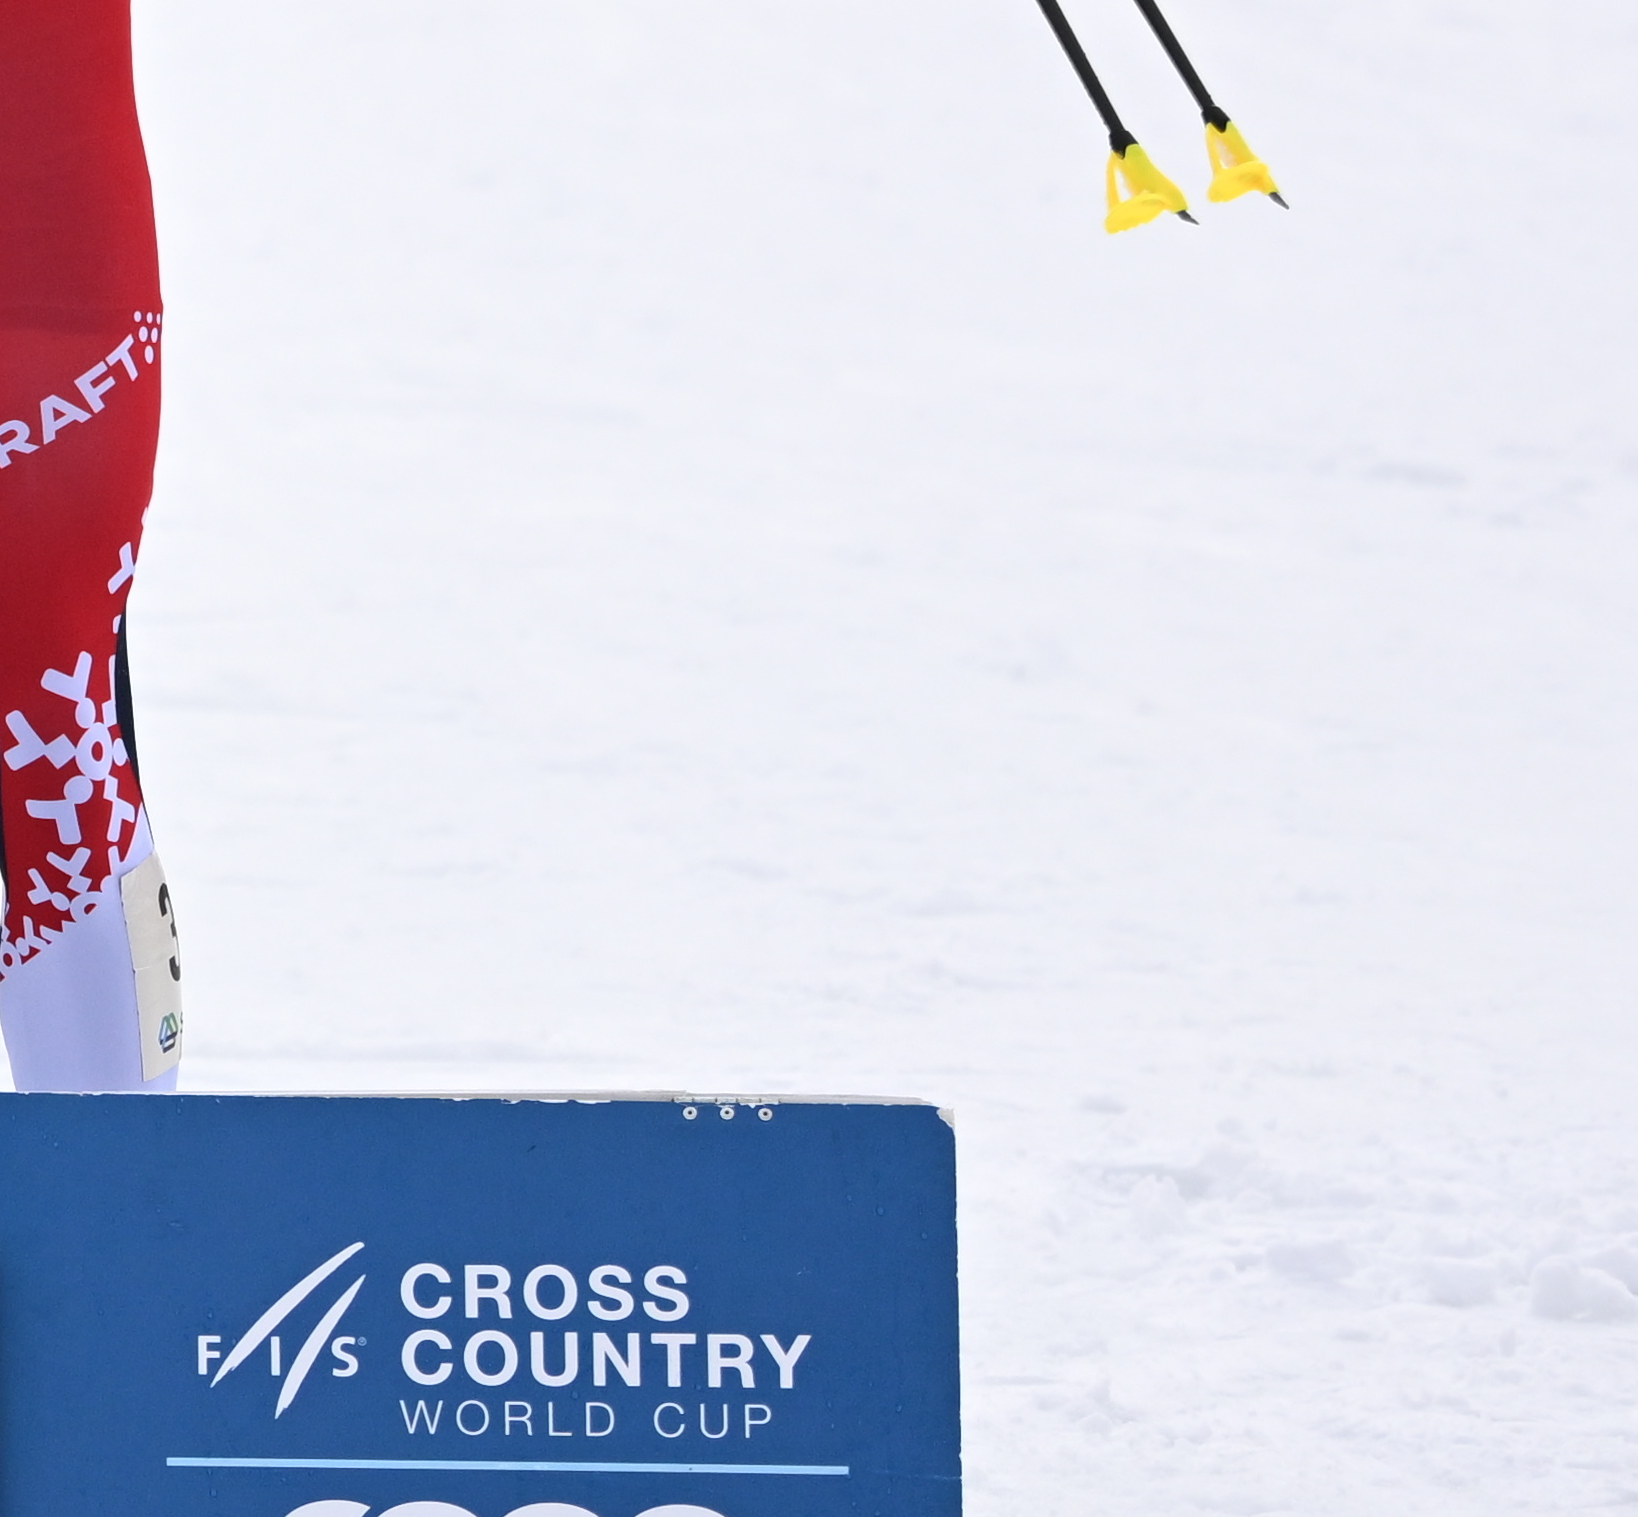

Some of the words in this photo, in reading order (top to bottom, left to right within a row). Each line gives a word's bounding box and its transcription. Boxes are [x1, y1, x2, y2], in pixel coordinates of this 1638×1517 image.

[400, 1263, 688, 1321] CROSS
[197, 1335, 357, 1379] FIS
[401, 1329, 811, 1391] COUNTRY
[400, 1400, 616, 1438] WORLD
[653, 1402, 772, 1441] CUP
